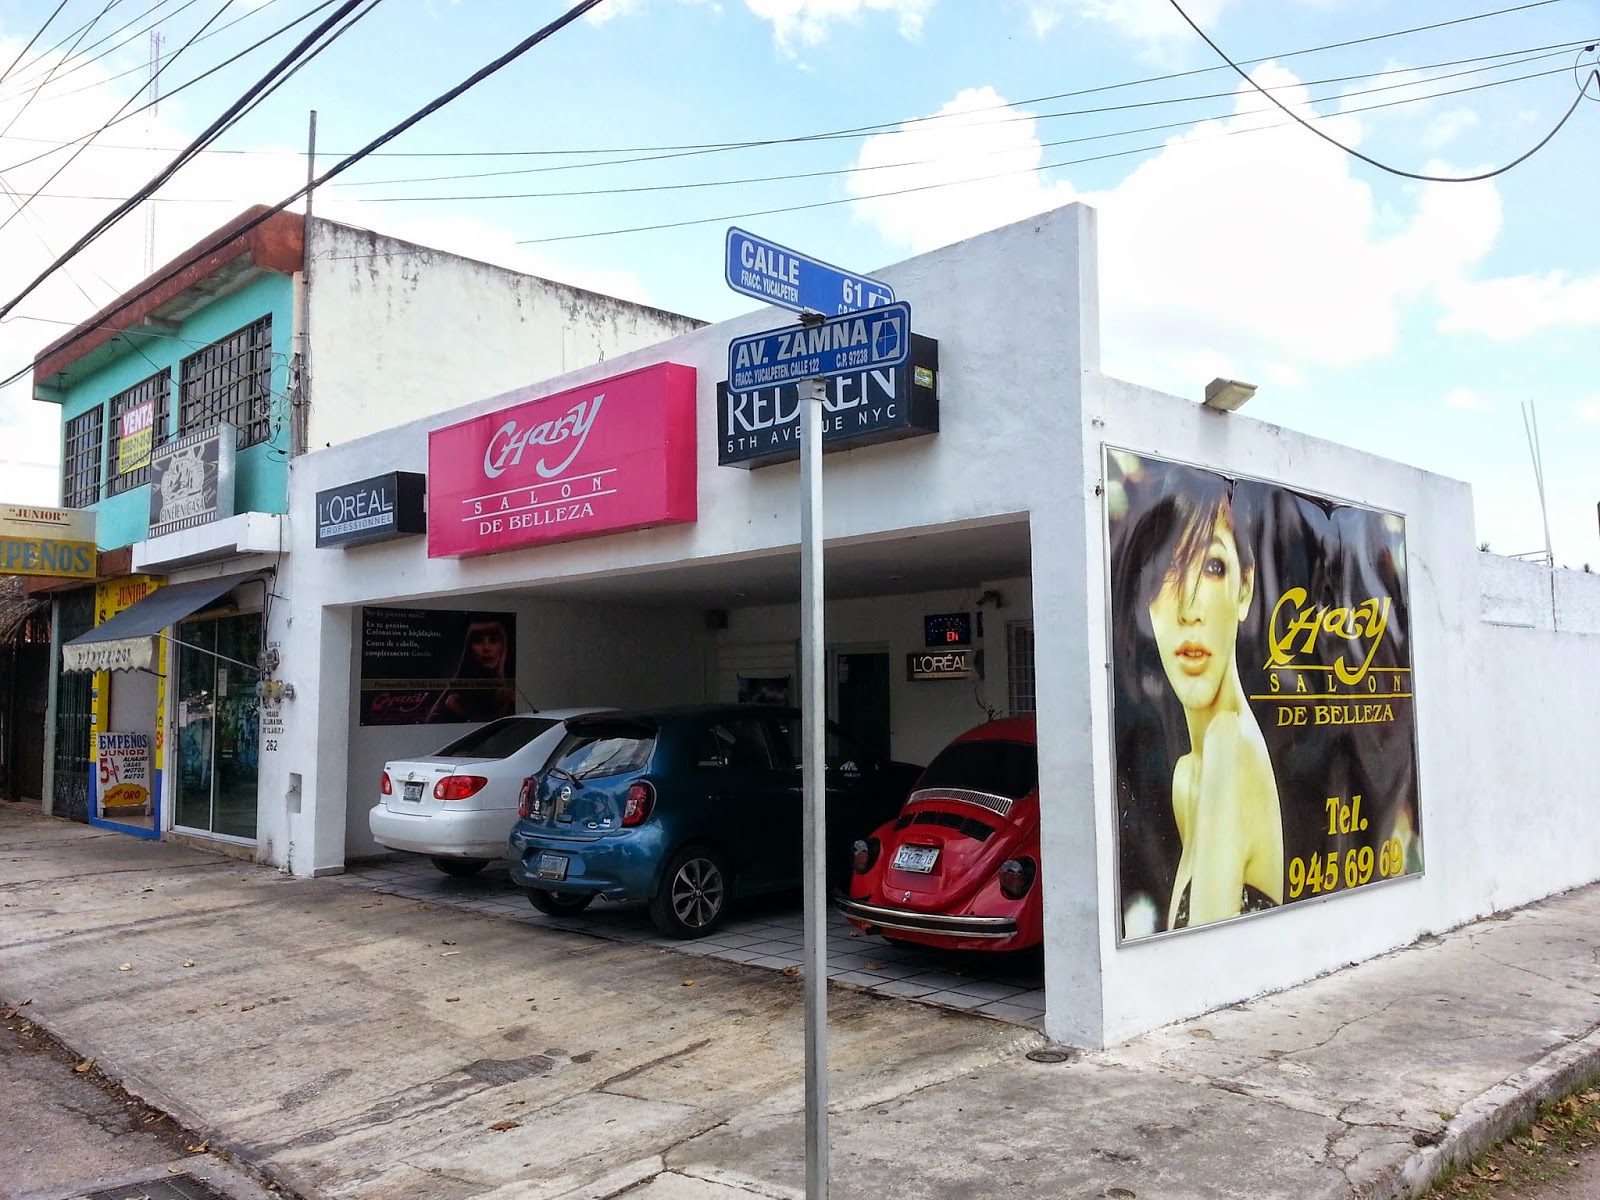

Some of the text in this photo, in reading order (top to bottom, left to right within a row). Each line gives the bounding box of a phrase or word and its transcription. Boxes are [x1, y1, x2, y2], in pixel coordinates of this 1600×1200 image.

[741, 240, 862, 308] CALLE 61
[741, 268, 762, 291] FRACC.
[762, 276, 799, 304] YUCALPETEN
[735, 318, 869, 370] AV. ZAMNA
[790, 359, 808, 377] CALLE
[809, 357, 820, 373] 122
[835, 353, 848, 368] C.P.
[848, 347, 869, 367] 97238
[122, 402, 154, 437] VENTA
[727, 403, 897, 453] 5TH AVEUE NYC
[319, 488, 394, 526] L'ORÉAL
[473, 476, 602, 515] SALON
[320, 514, 392, 537] PROFESSIONNEL
[479, 502, 595, 536] DE BELLEZA
[0, 539, 91, 573] PEÑOS
[913, 653, 971, 673] L'ORÉAL
[1269, 673, 1402, 693] SALON
[1276, 703, 1395, 727] DE BELLEZA
[99, 732, 147, 750] EMPEÑOS
[100, 749, 145, 757] JUNIOR
[266, 739, 278, 751] 262
[123, 790, 141, 800] ORO
[1325, 794, 1369, 836] Tel.
[1288, 837, 1404, 899] 945 69 69
